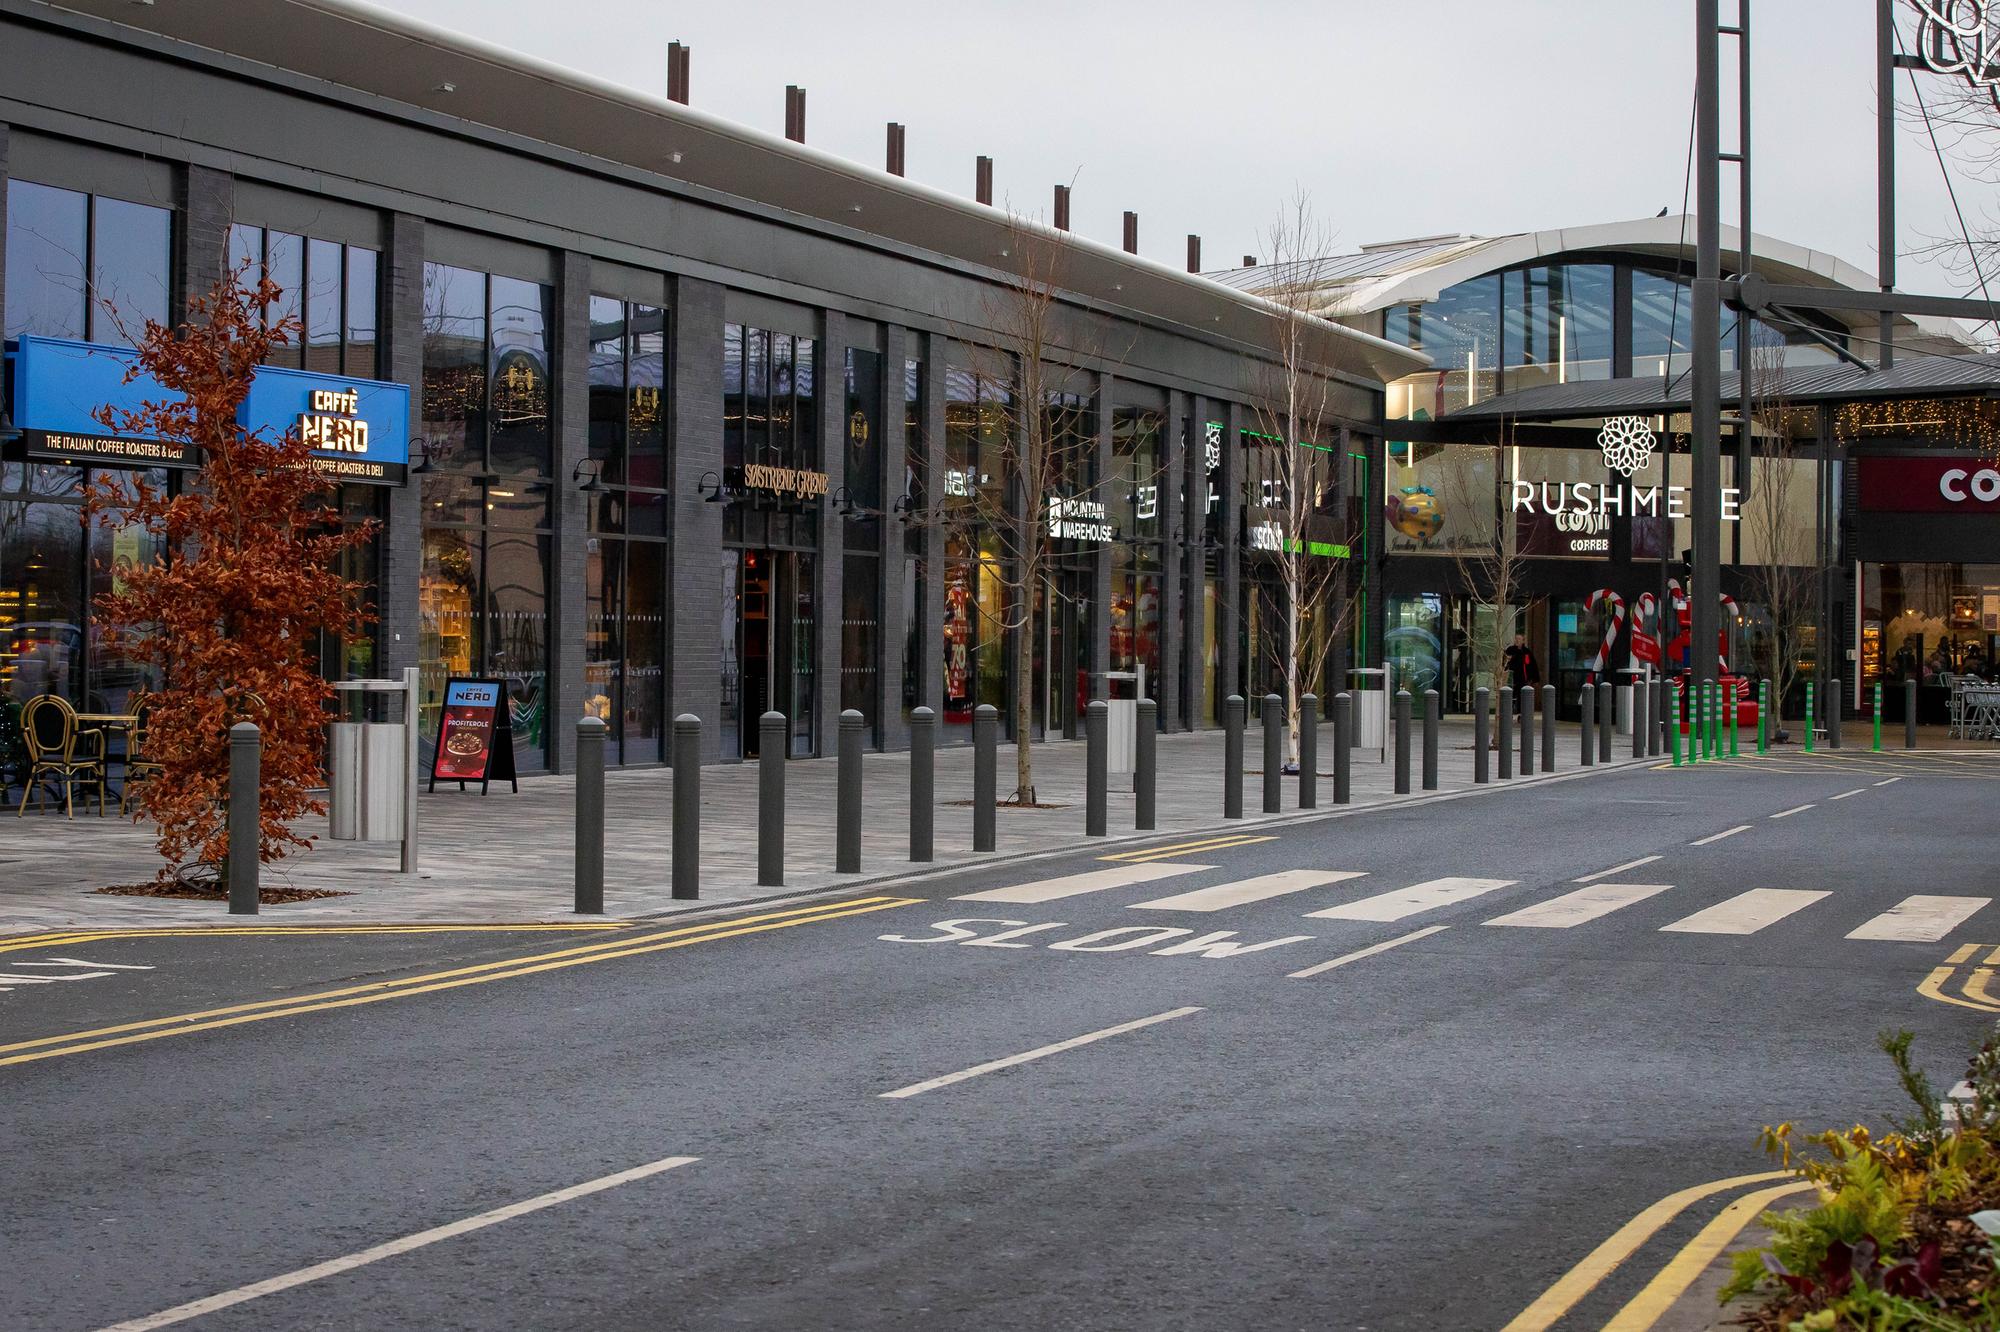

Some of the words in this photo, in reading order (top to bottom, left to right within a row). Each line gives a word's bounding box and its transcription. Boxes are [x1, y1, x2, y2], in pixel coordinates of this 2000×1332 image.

[313, 387, 358, 414] CAFFÈ
[303, 414, 368, 453] NERO
[46, 435, 61, 449] THE
[63, 437, 94, 451] ITALIAN
[96, 440, 124, 454] COFFEE
[126, 443, 160, 457] ROASTERS
[161, 446, 167, 458] &
[312, 459, 336, 473] COFFEE
[337, 461, 365, 475] ROASTERS
[365, 464, 371, 475] &
[371, 465, 384, 477] DELI
[1063, 499, 1105, 520] MOUNTAIN
[1512, 480, 1740, 520] RUSHMEE
[1062, 522, 1113, 542] WAREHOUSE
[455, 692, 491, 701] NERO
[877, 918, 1317, 959] SLOW
